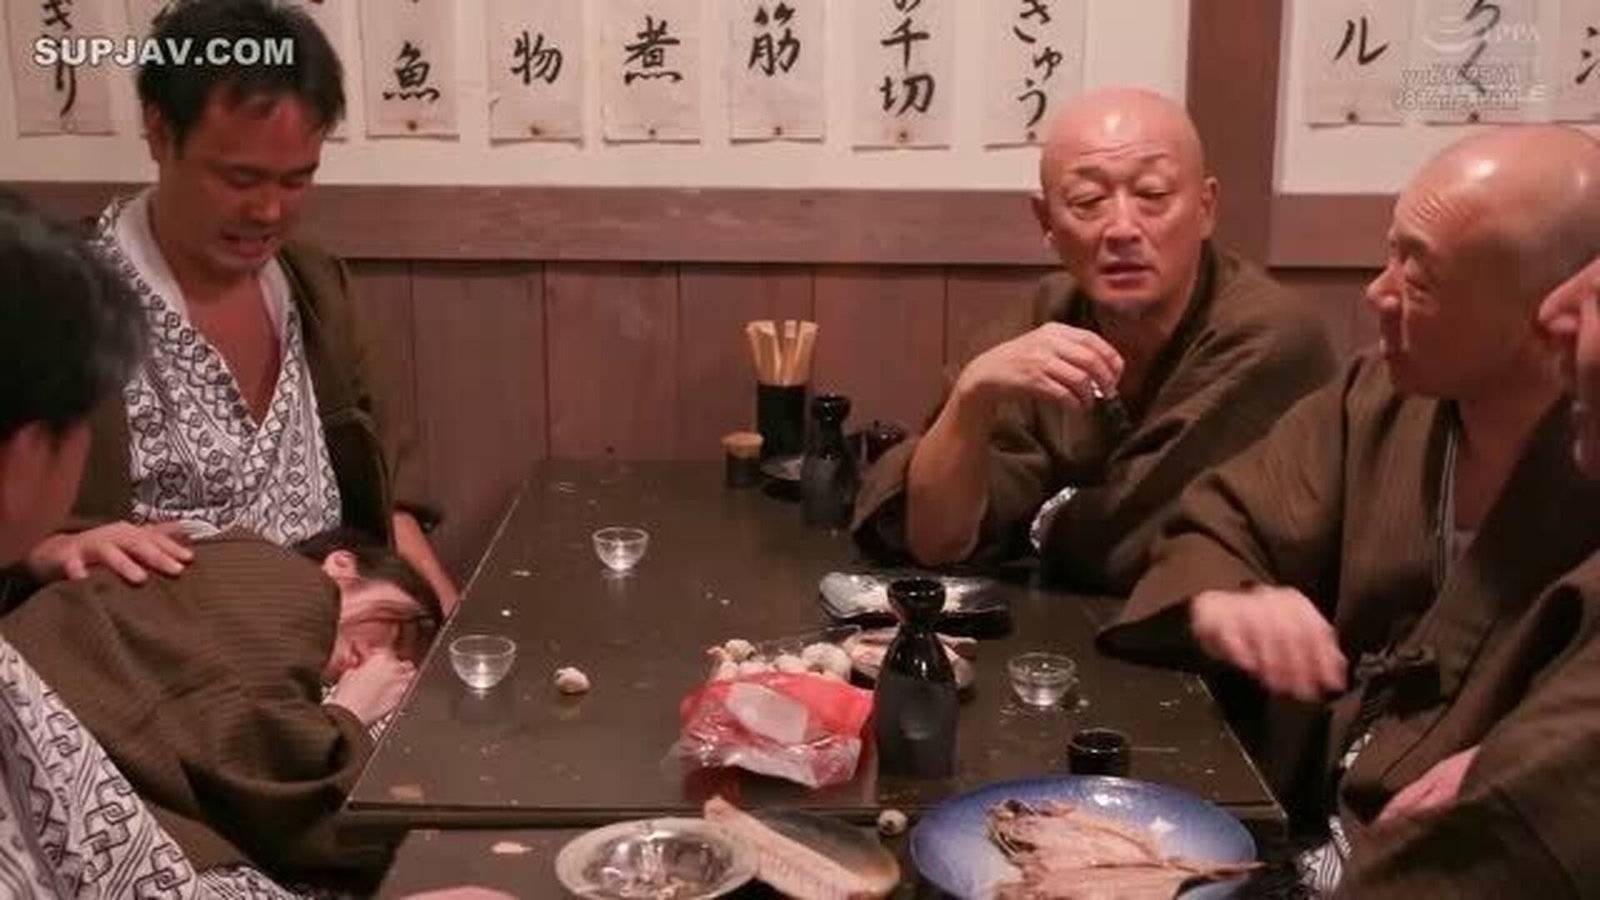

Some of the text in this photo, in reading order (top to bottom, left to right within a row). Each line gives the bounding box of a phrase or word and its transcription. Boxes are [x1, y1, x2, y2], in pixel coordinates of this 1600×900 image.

[510, 30, 563, 86] 物
[623, 15, 684, 85] 煮
[748, 0, 801, 77] 筋
[1013, 0, 1063, 128] きゅう
[1333, 16, 1389, 65] ル
[382, 41, 441, 102] 魚
